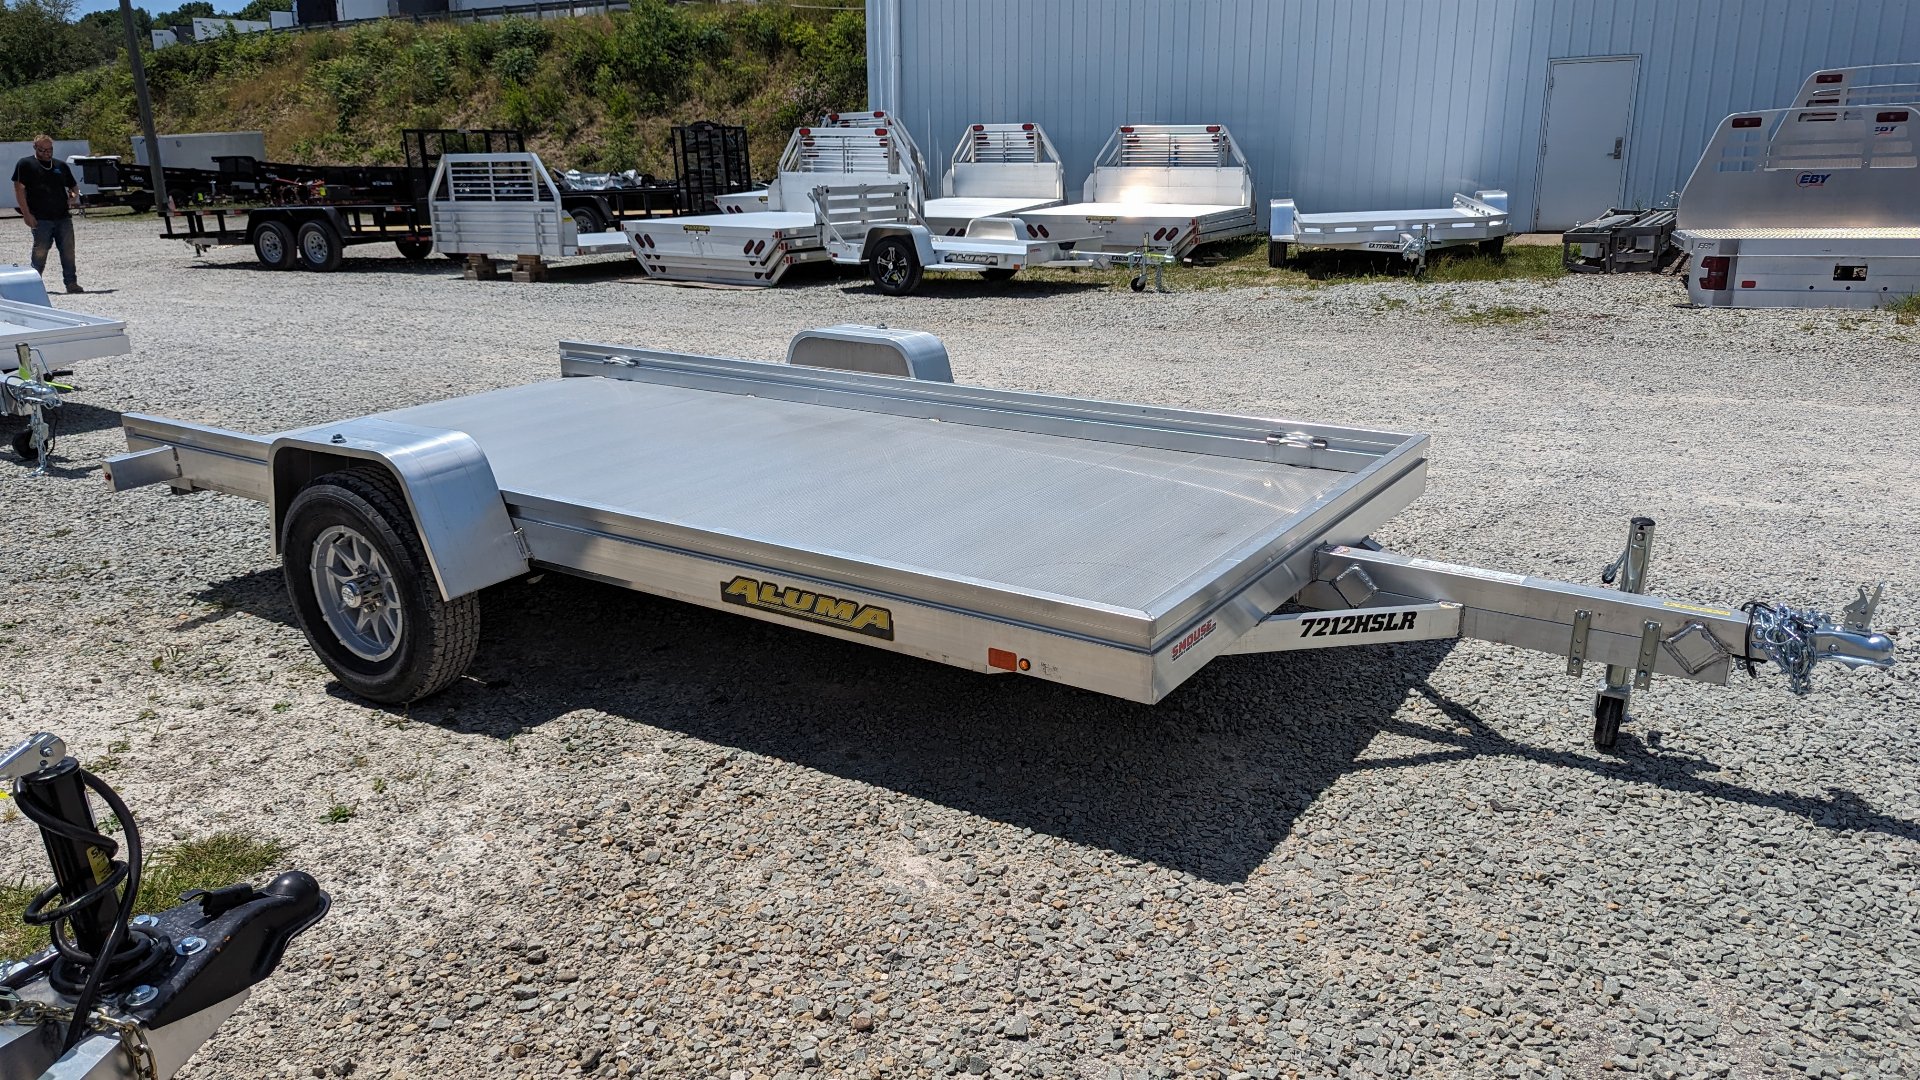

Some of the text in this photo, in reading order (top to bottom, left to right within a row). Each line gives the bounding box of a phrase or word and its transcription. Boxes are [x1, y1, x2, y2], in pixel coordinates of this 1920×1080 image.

[1799, 174, 1831, 184] EBY
[945, 253, 998, 265] ALUMA
[724, 576, 890, 631] ALUMA
[1300, 611, 1418, 638] 7212HSLR
[1171, 619, 1217, 659] SMOUSE
